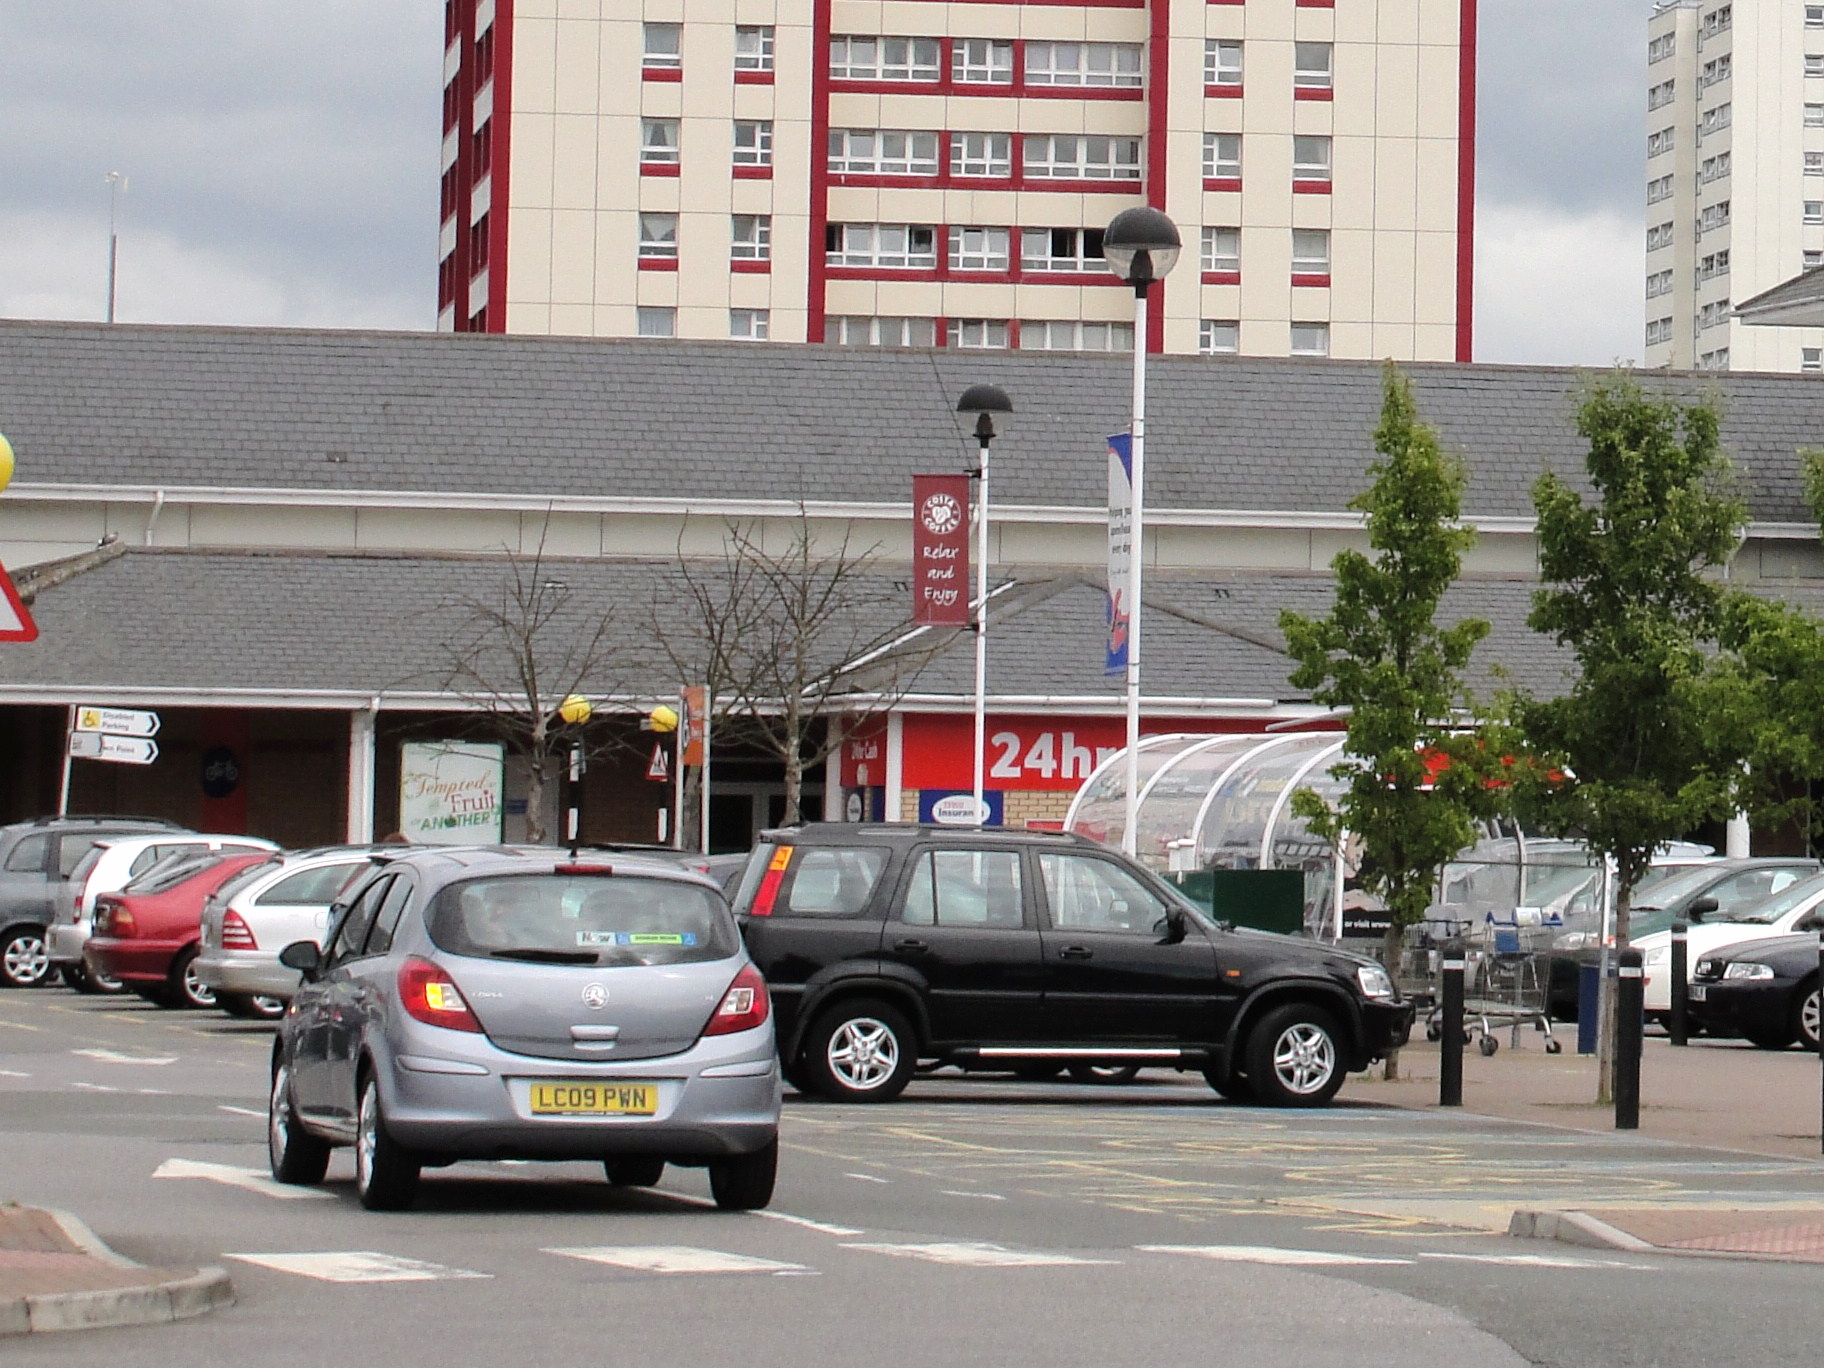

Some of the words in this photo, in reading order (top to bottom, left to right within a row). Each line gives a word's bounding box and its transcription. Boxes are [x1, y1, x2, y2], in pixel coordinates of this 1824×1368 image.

[927, 495, 955, 508] COSTA
[925, 517, 959, 533] COFFEE
[923, 543, 959, 559] Relax
[927, 565, 955, 580] and
[924, 586, 959, 606] Enjoy
[990, 731, 1117, 779] 24hr
[451, 790, 495, 813] Fruit
[938, 807, 985, 818] Insuran
[539, 1087, 596, 1108] LC09
[604, 1087, 646, 1106] PWN
